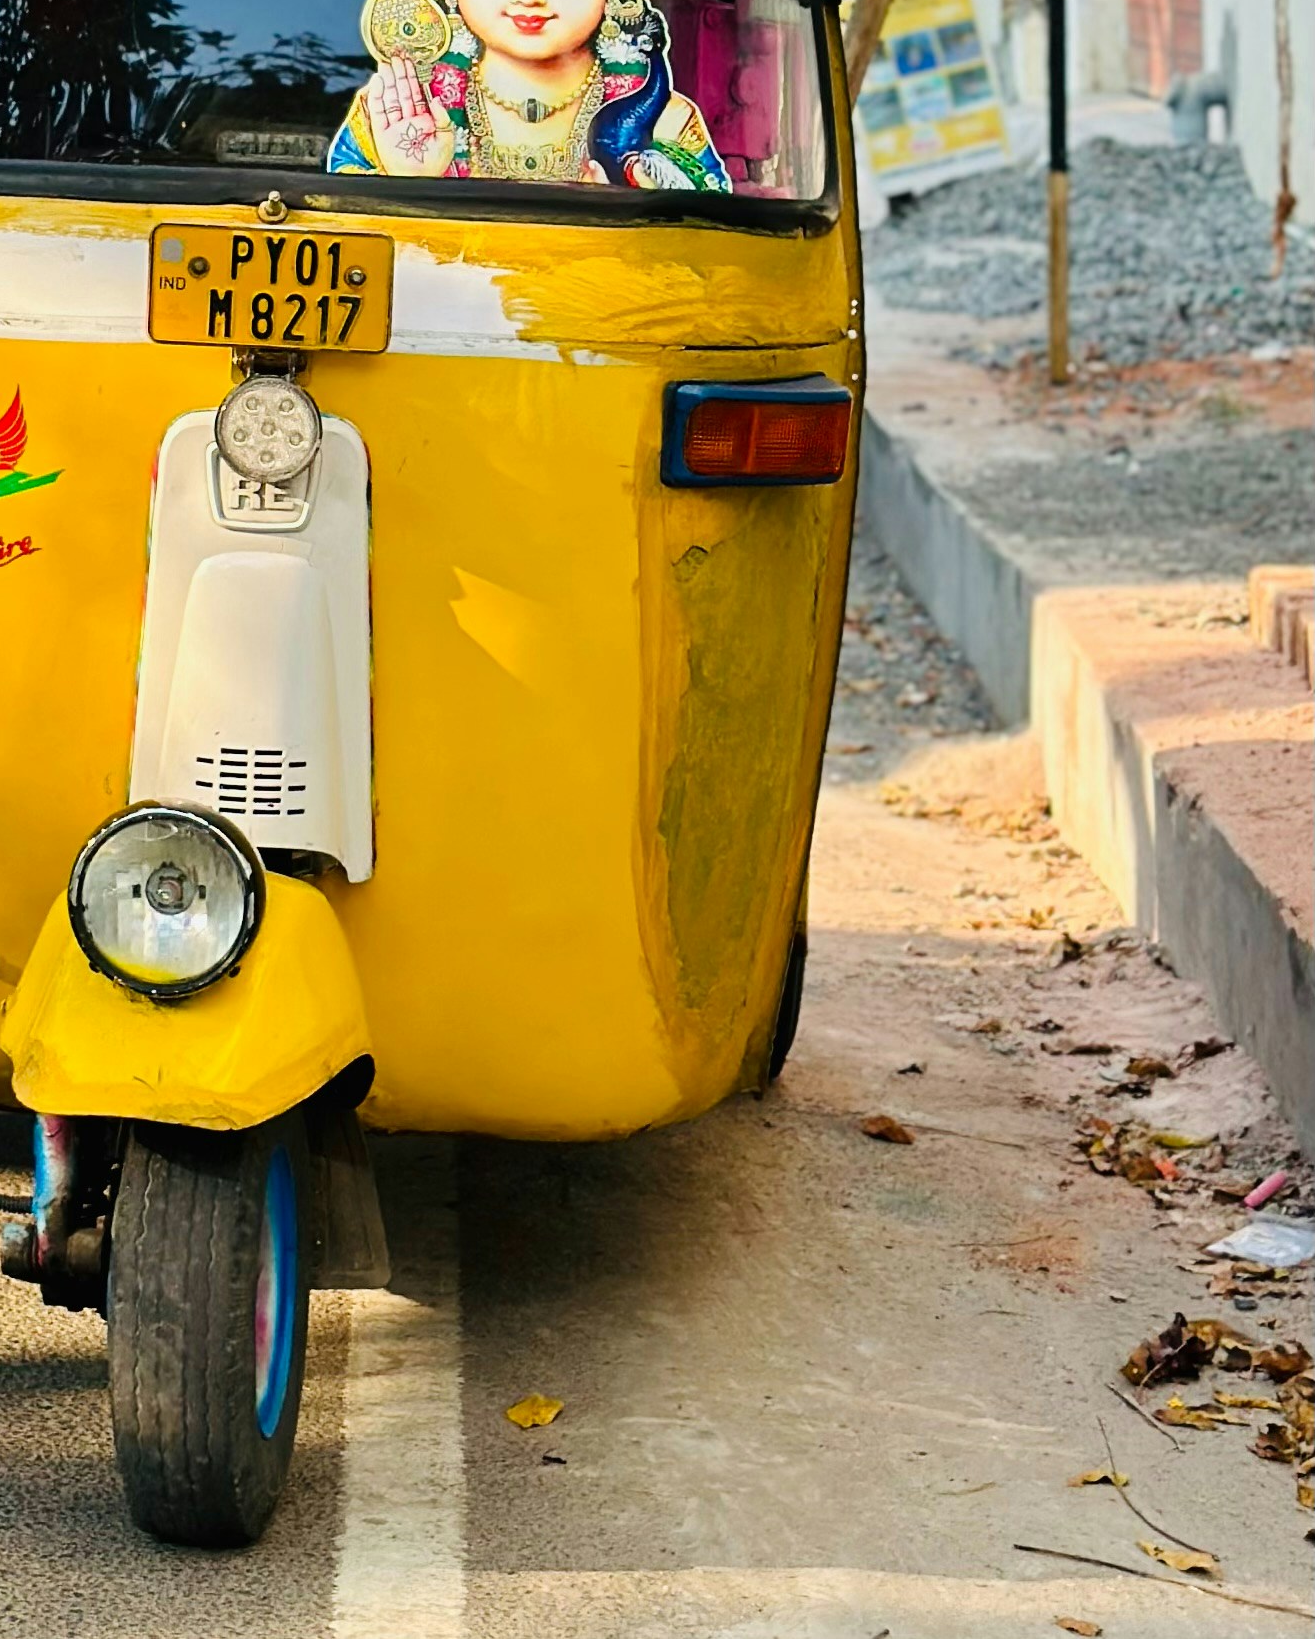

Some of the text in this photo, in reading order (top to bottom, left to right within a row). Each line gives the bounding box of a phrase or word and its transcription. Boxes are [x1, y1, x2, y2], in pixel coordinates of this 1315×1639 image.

[159, 276, 186, 291] IND
[231, 235, 341, 290] PY01
[251, 292, 362, 344] 8217
